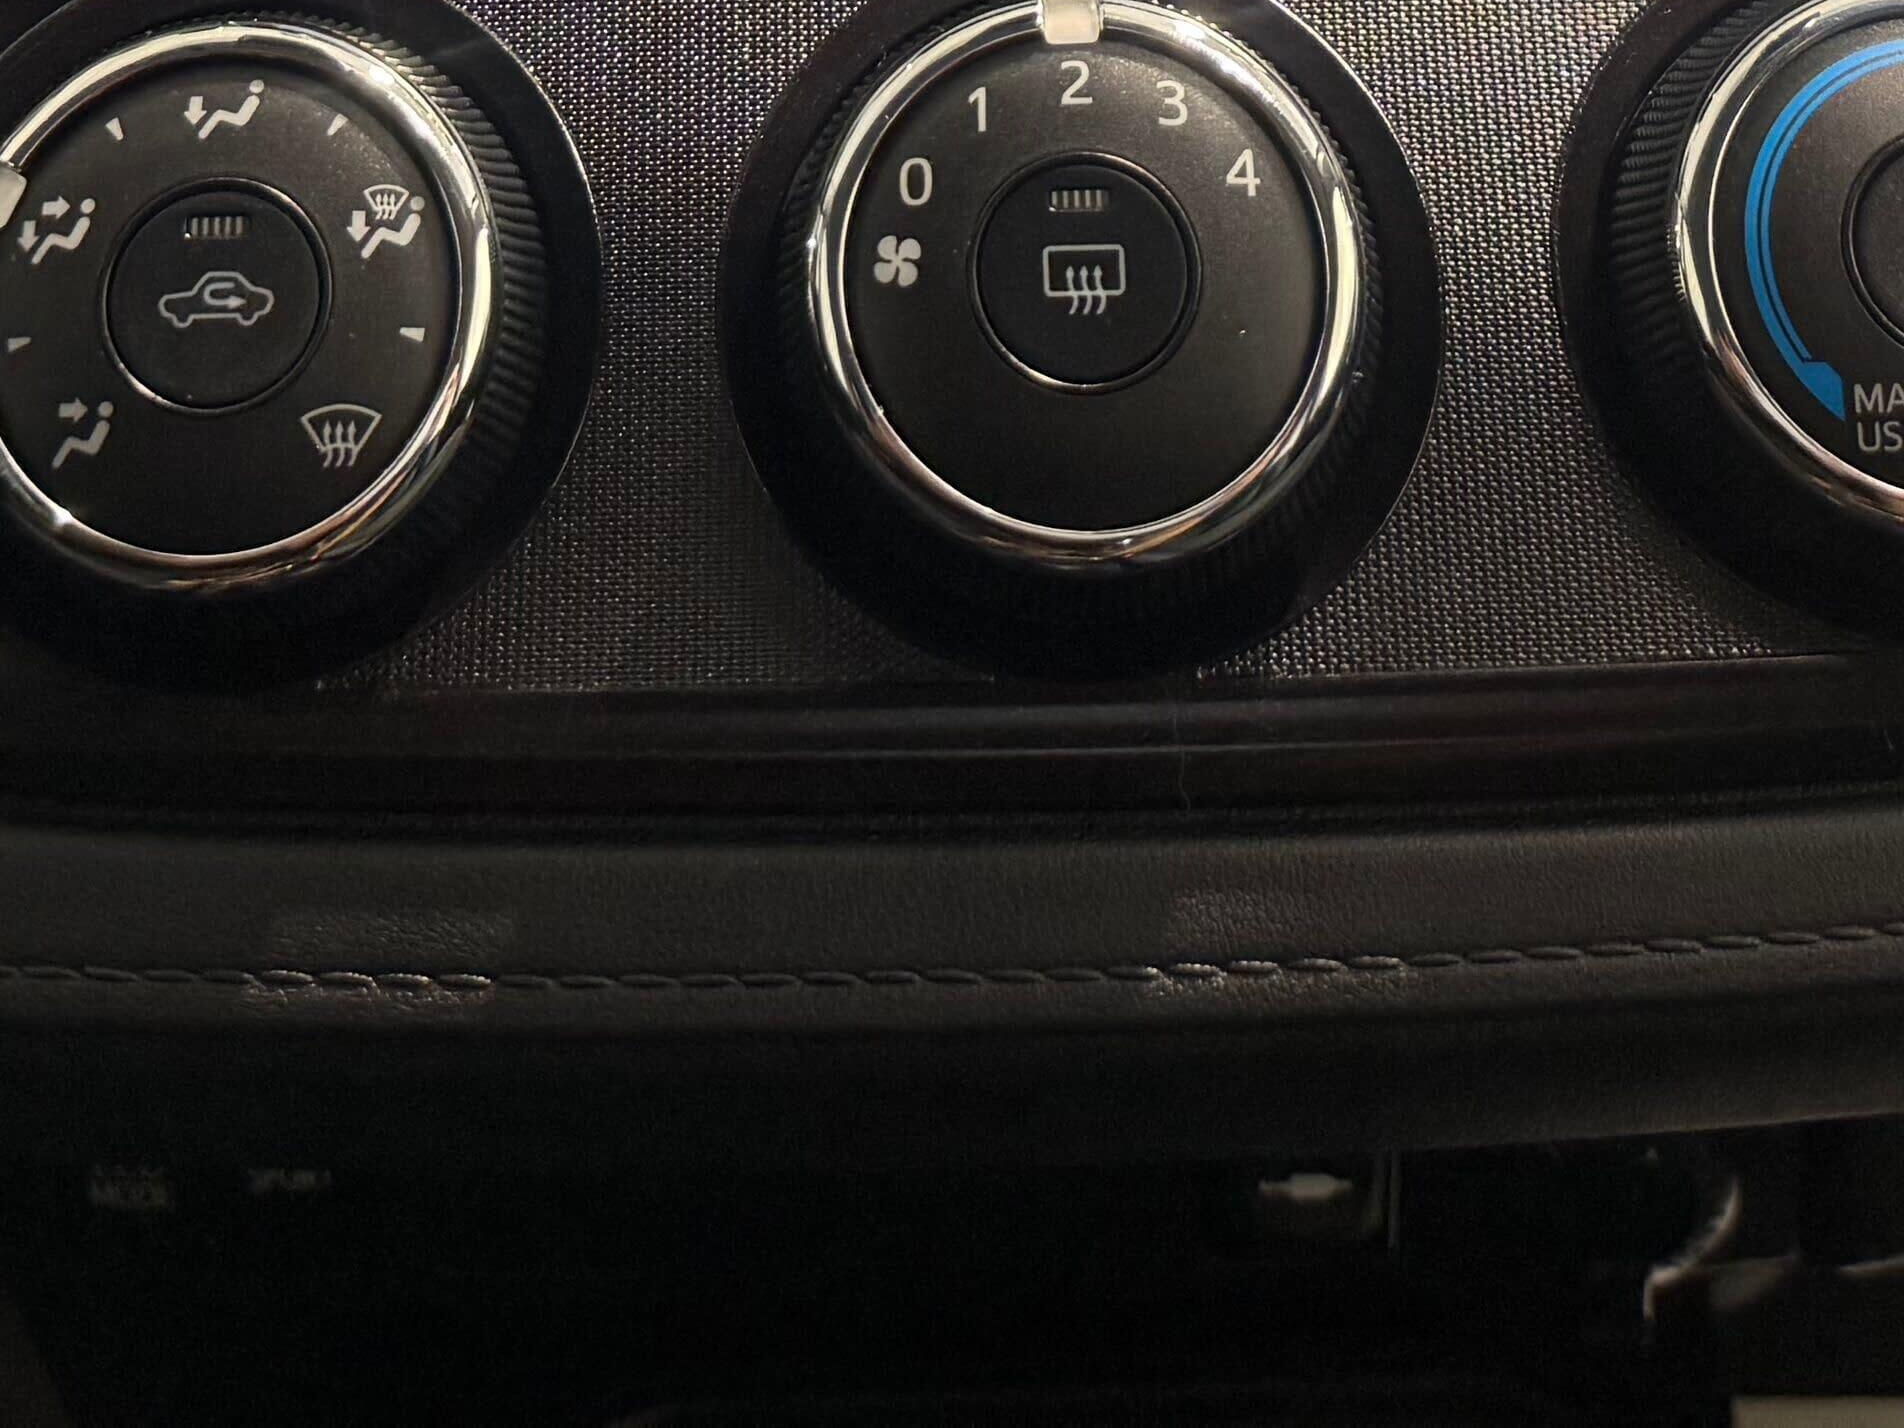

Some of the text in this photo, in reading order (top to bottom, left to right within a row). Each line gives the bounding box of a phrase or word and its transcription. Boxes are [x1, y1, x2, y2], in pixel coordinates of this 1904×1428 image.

[1061, 60, 1092, 104] 2
[1156, 80, 1187, 125] 3
[969, 87, 986, 131] 1
[900, 158, 932, 205] 0
[1227, 149, 1260, 196] 4
